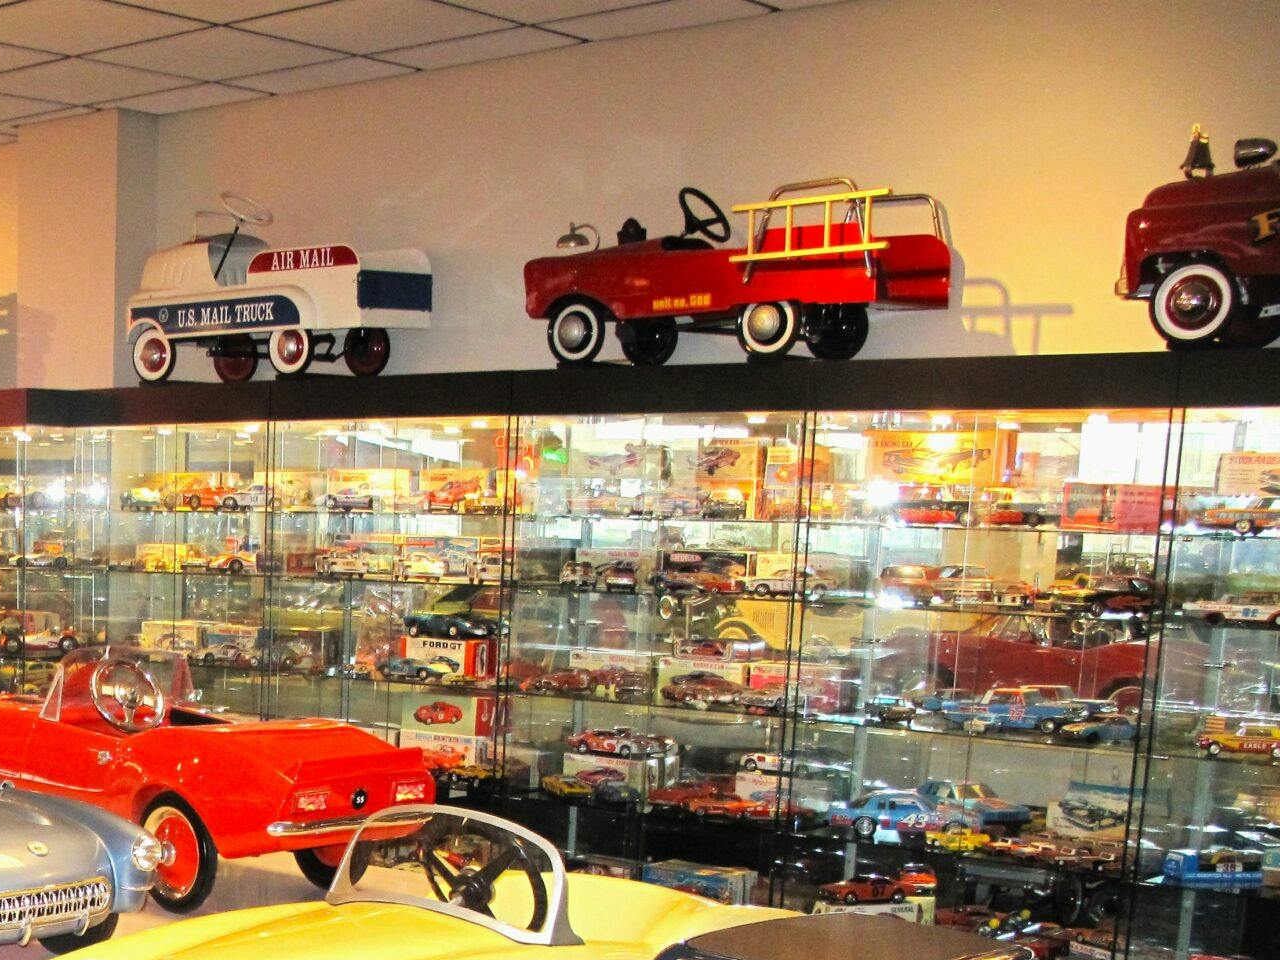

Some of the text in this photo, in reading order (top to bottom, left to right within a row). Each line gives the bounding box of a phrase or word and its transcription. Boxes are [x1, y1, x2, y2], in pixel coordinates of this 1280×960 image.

[271, 248, 334, 271] AIR MAIL
[177, 302, 274, 327] U.S. MAIL TRUCK
[422, 640, 449, 648] FORD
[901, 814, 929, 828] 43
